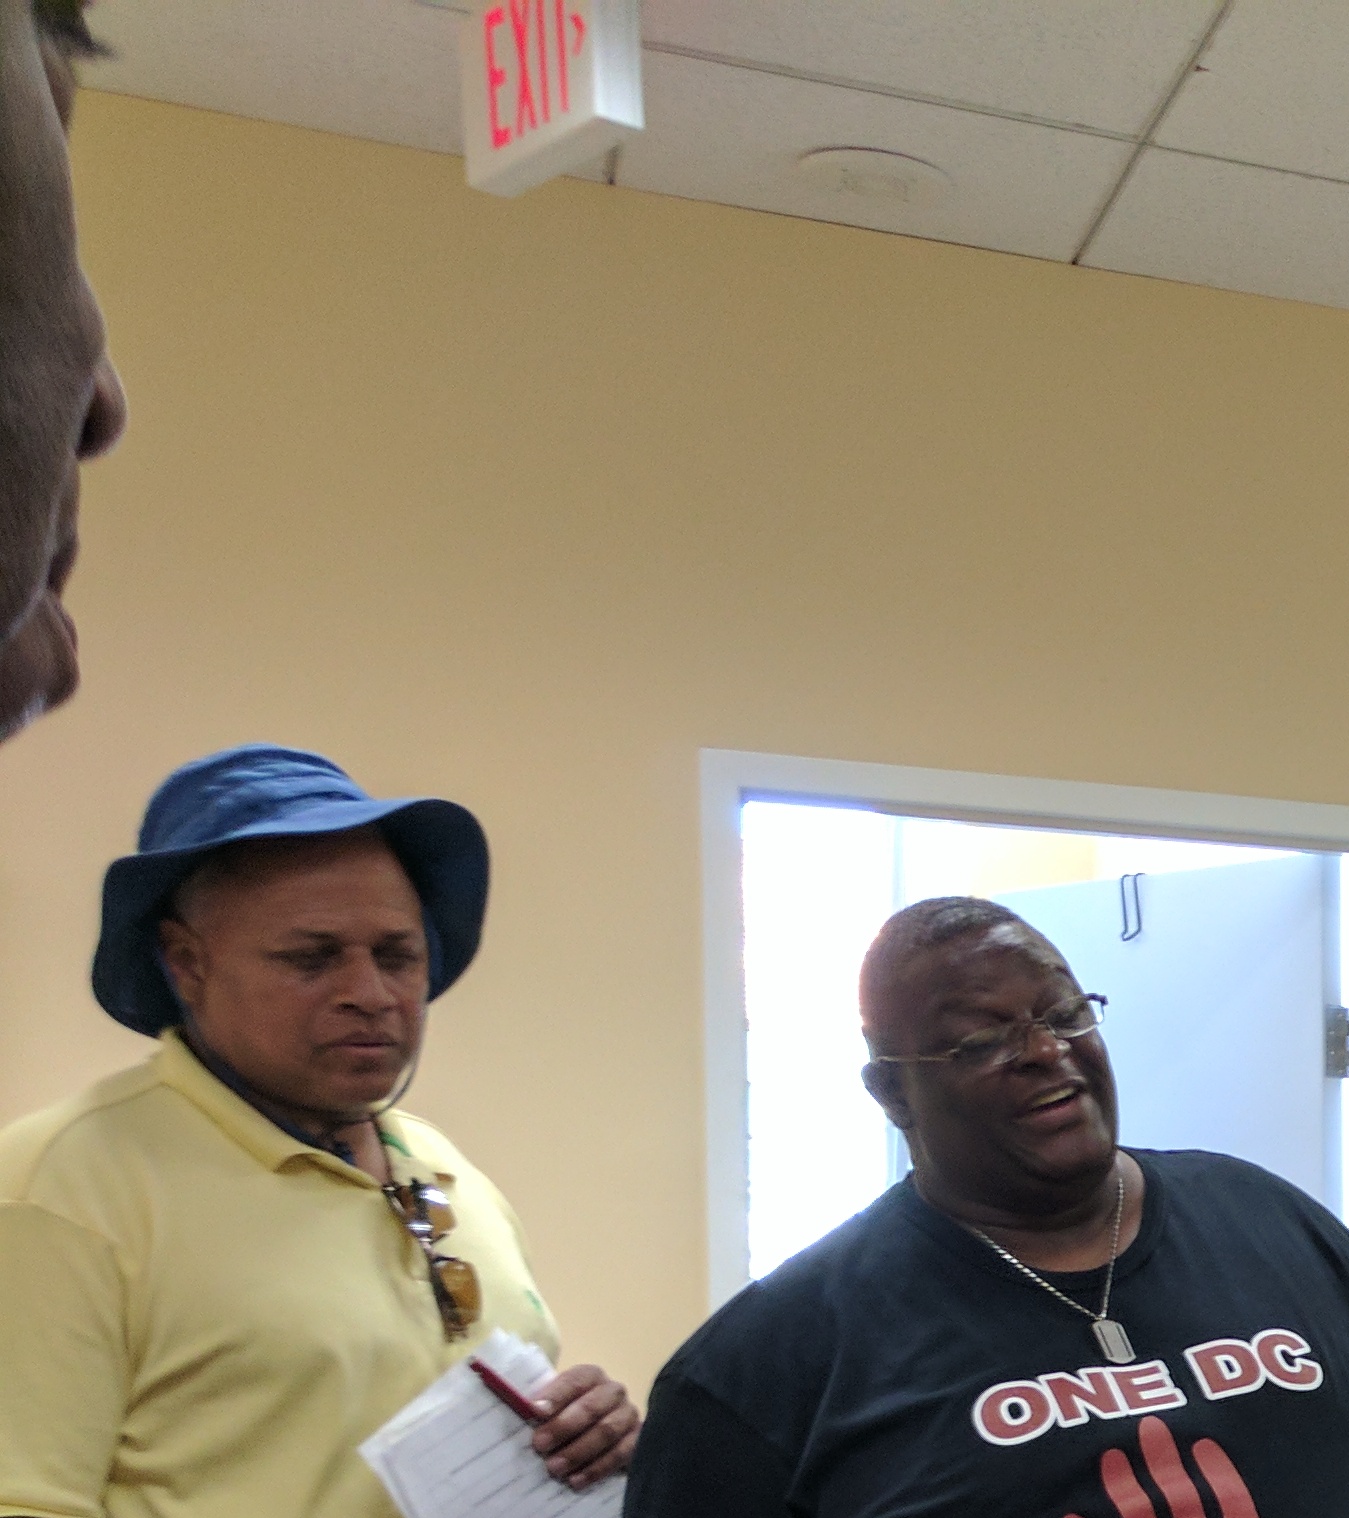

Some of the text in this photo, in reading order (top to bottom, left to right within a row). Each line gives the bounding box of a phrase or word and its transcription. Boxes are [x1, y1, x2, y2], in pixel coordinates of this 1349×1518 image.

[483, 0, 569, 150] EXIT
[971, 1327, 1325, 1446] ONE DC
